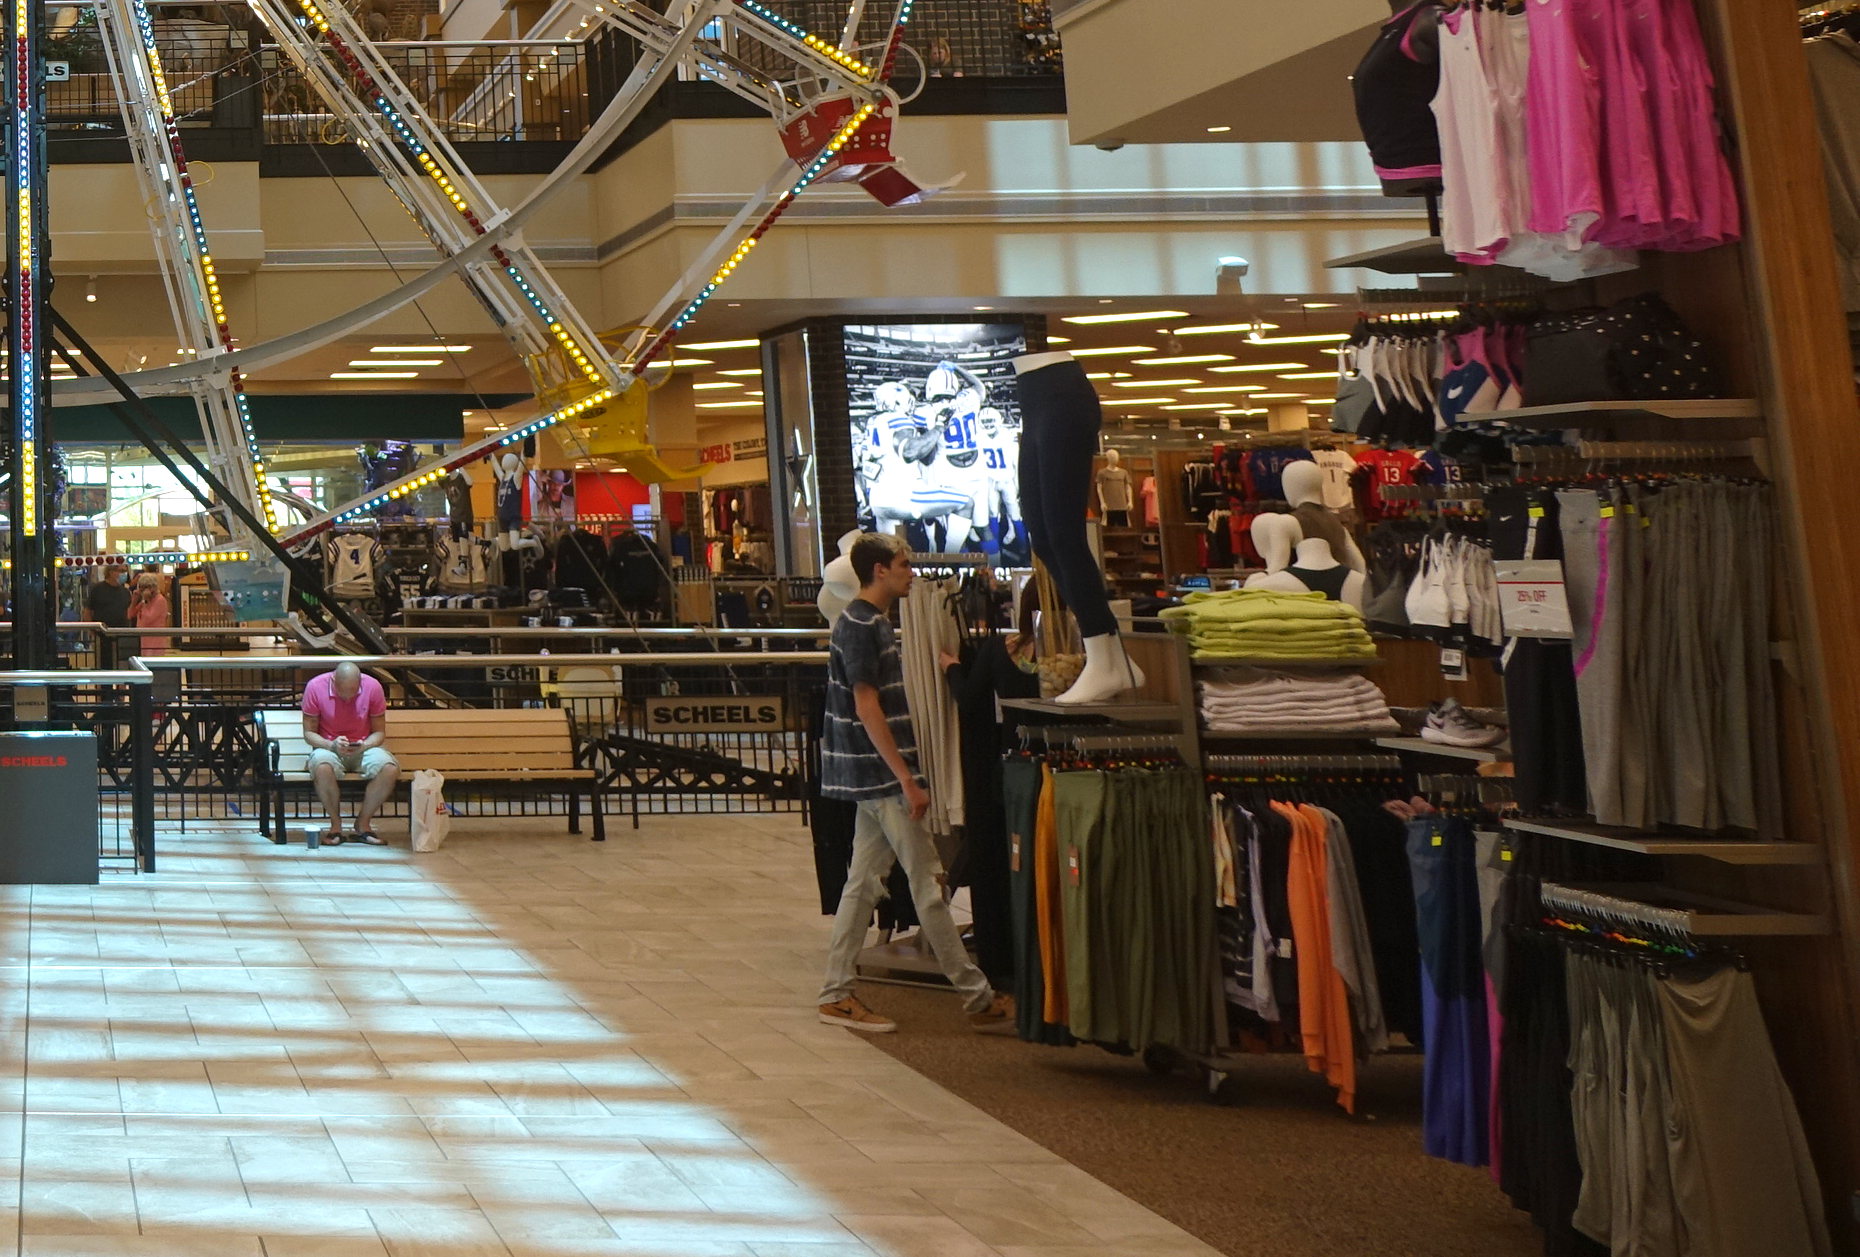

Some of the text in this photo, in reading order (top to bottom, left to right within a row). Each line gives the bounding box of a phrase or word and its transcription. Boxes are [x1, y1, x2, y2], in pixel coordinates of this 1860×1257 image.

[944, 412, 979, 450] 90
[983, 447, 1007, 470] 31
[1329, 469, 1336, 483] 1
[1383, 467, 1401, 483] 13
[1444, 465, 1462, 481] 13
[349, 548, 361, 565] 4
[399, 583, 421, 601] 55
[1533, 590, 1548, 602] OFF
[653, 705, 777, 725] SCHEELS
[0, 755, 67, 767] SCHEELS
